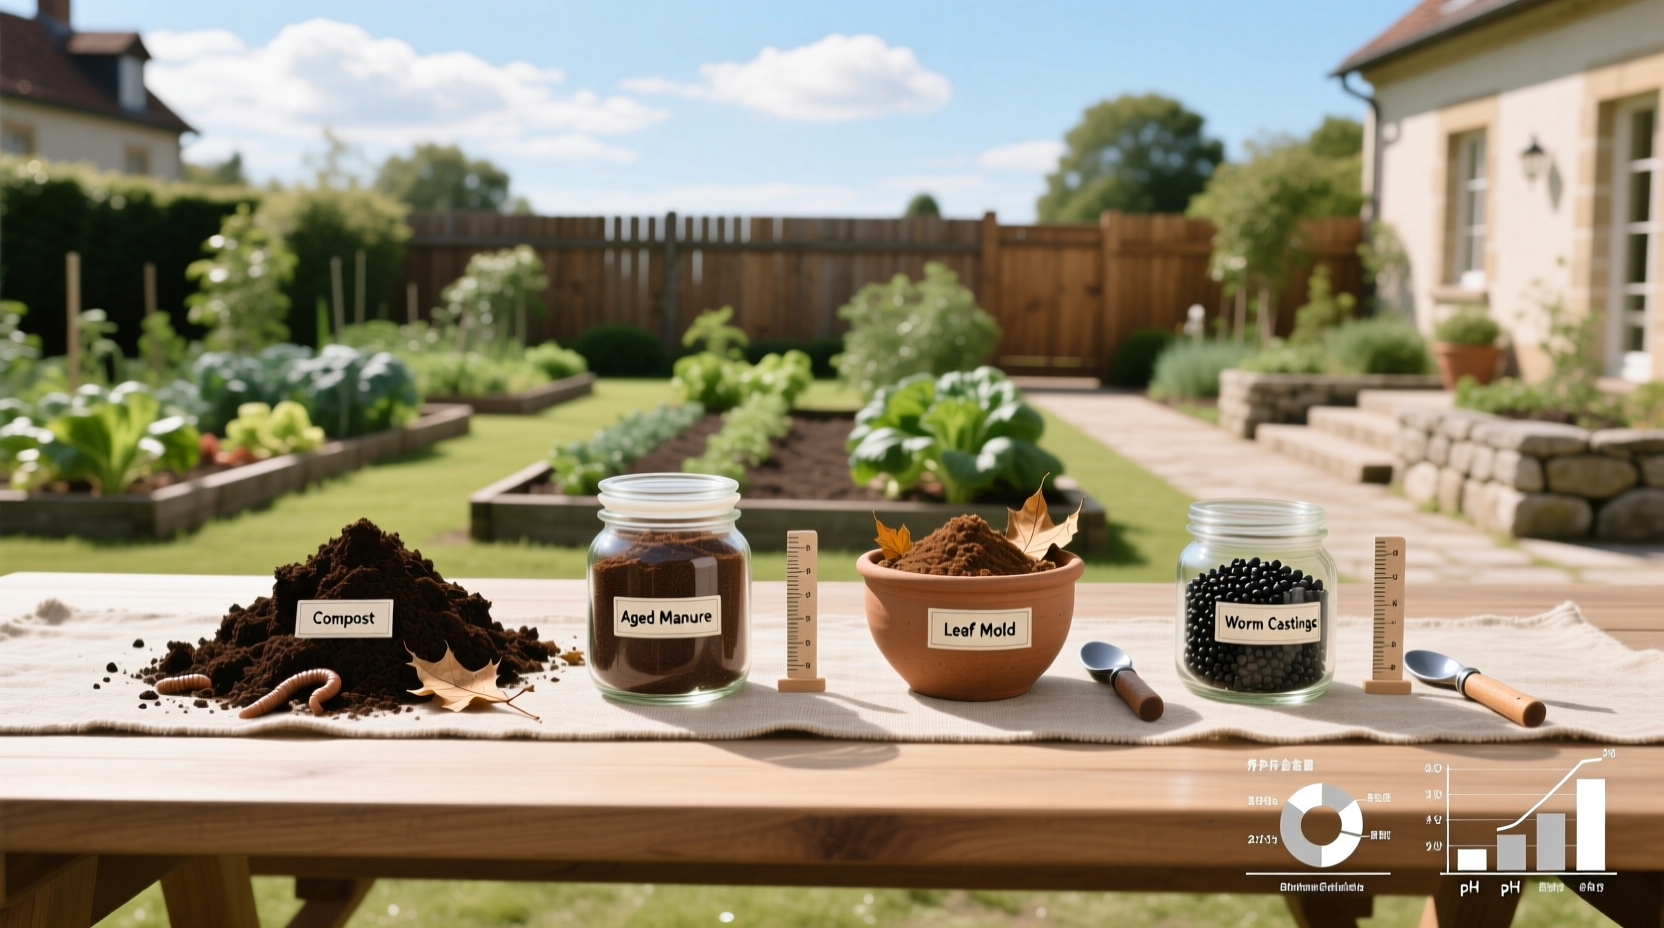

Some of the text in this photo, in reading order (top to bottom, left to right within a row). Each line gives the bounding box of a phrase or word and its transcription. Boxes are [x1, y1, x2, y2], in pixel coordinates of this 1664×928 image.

[313, 611, 375, 628] Compost
[620, 609, 713, 627] Aged Manure
[1225, 615, 1317, 632] Worm Castings
[944, 622, 1016, 638] Leaf Mold
